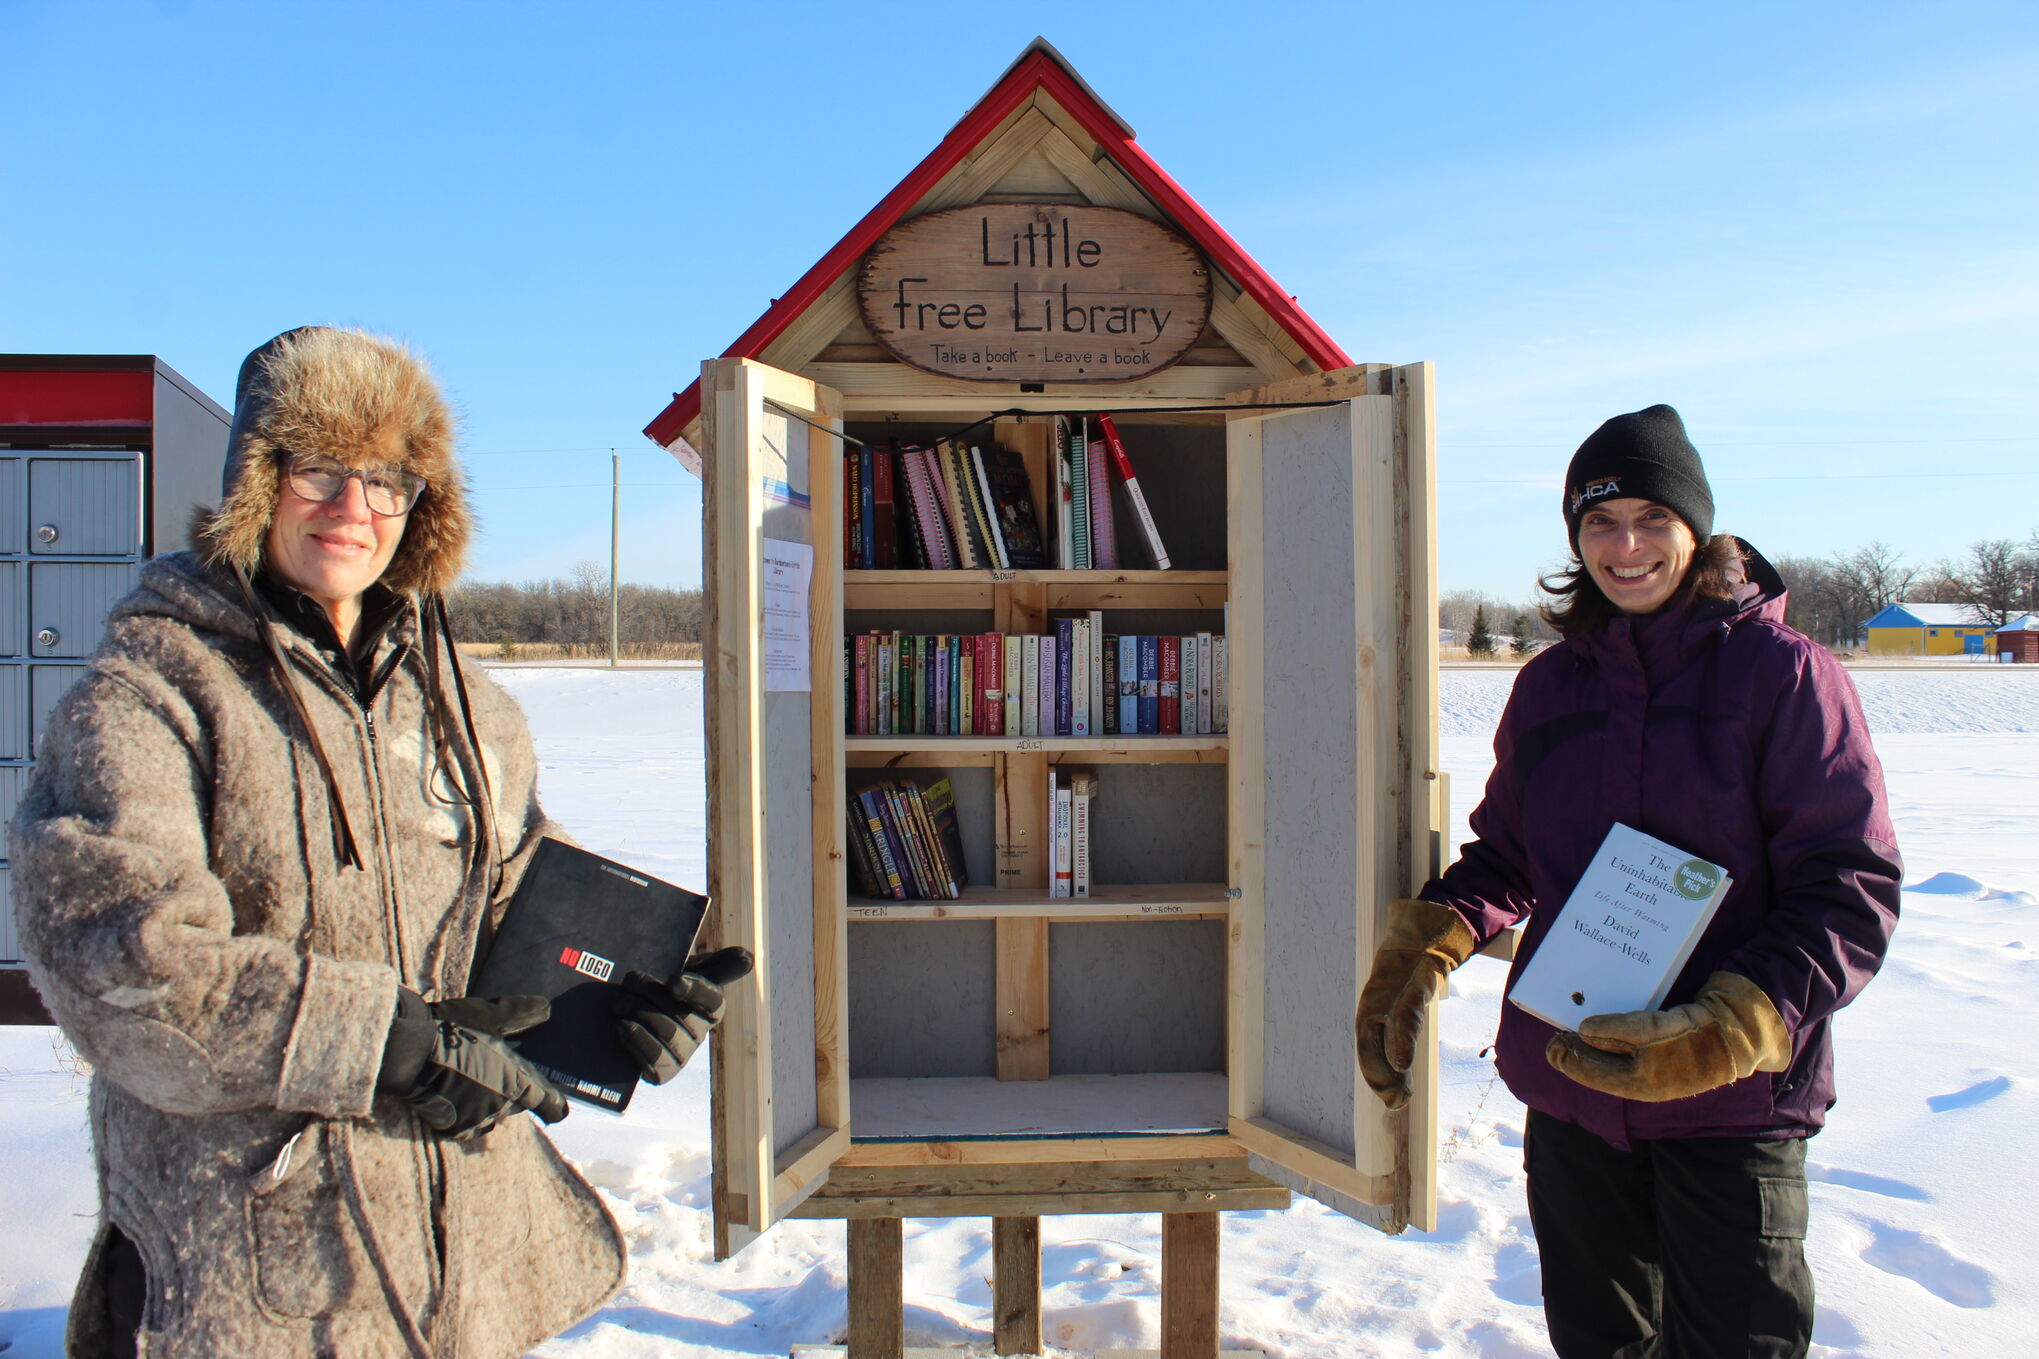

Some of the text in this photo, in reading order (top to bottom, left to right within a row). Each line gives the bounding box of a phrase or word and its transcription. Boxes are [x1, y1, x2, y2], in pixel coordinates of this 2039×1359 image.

[982, 216, 1101, 268] Little
[1014, 282, 1172, 345] Library
[929, 344, 967, 364] Take
[972, 352, 980, 364] a
[986, 346, 1018, 363] book
[1044, 347, 1092, 364] Leave
[1100, 351, 1108, 364] a
[1114, 347, 1151, 365] book
[852, 483, 860, 520] HOPKINSON
[992, 572, 1017, 581] ADULT
[1042, 652, 1052, 702] SUSAN MALLERY
[1186, 650, 1195, 690] NORA ROBERTS
[1060, 677, 1068, 697] Village
[862, 831, 882, 873] STARDUST
[873, 829, 896, 874] KRINGLE
[1078, 844, 1086, 879] ANTARCTICA
[1648, 854, 1672, 873] The
[1681, 866, 1716, 888] Heather's
[1683, 879, 1701, 894] Pick
[1624, 882, 1657, 905] Earth
[853, 906, 888, 917] TEEN
[1594, 890, 1670, 933] Life After Warming
[1603, 915, 1640, 940] David
[1574, 919, 1652, 966] Wallace-Wells
[560, 947, 611, 979] NO LOGO
[576, 1080, 600, 1097] NAOMI
[600, 1084, 622, 1103] KLEIN
